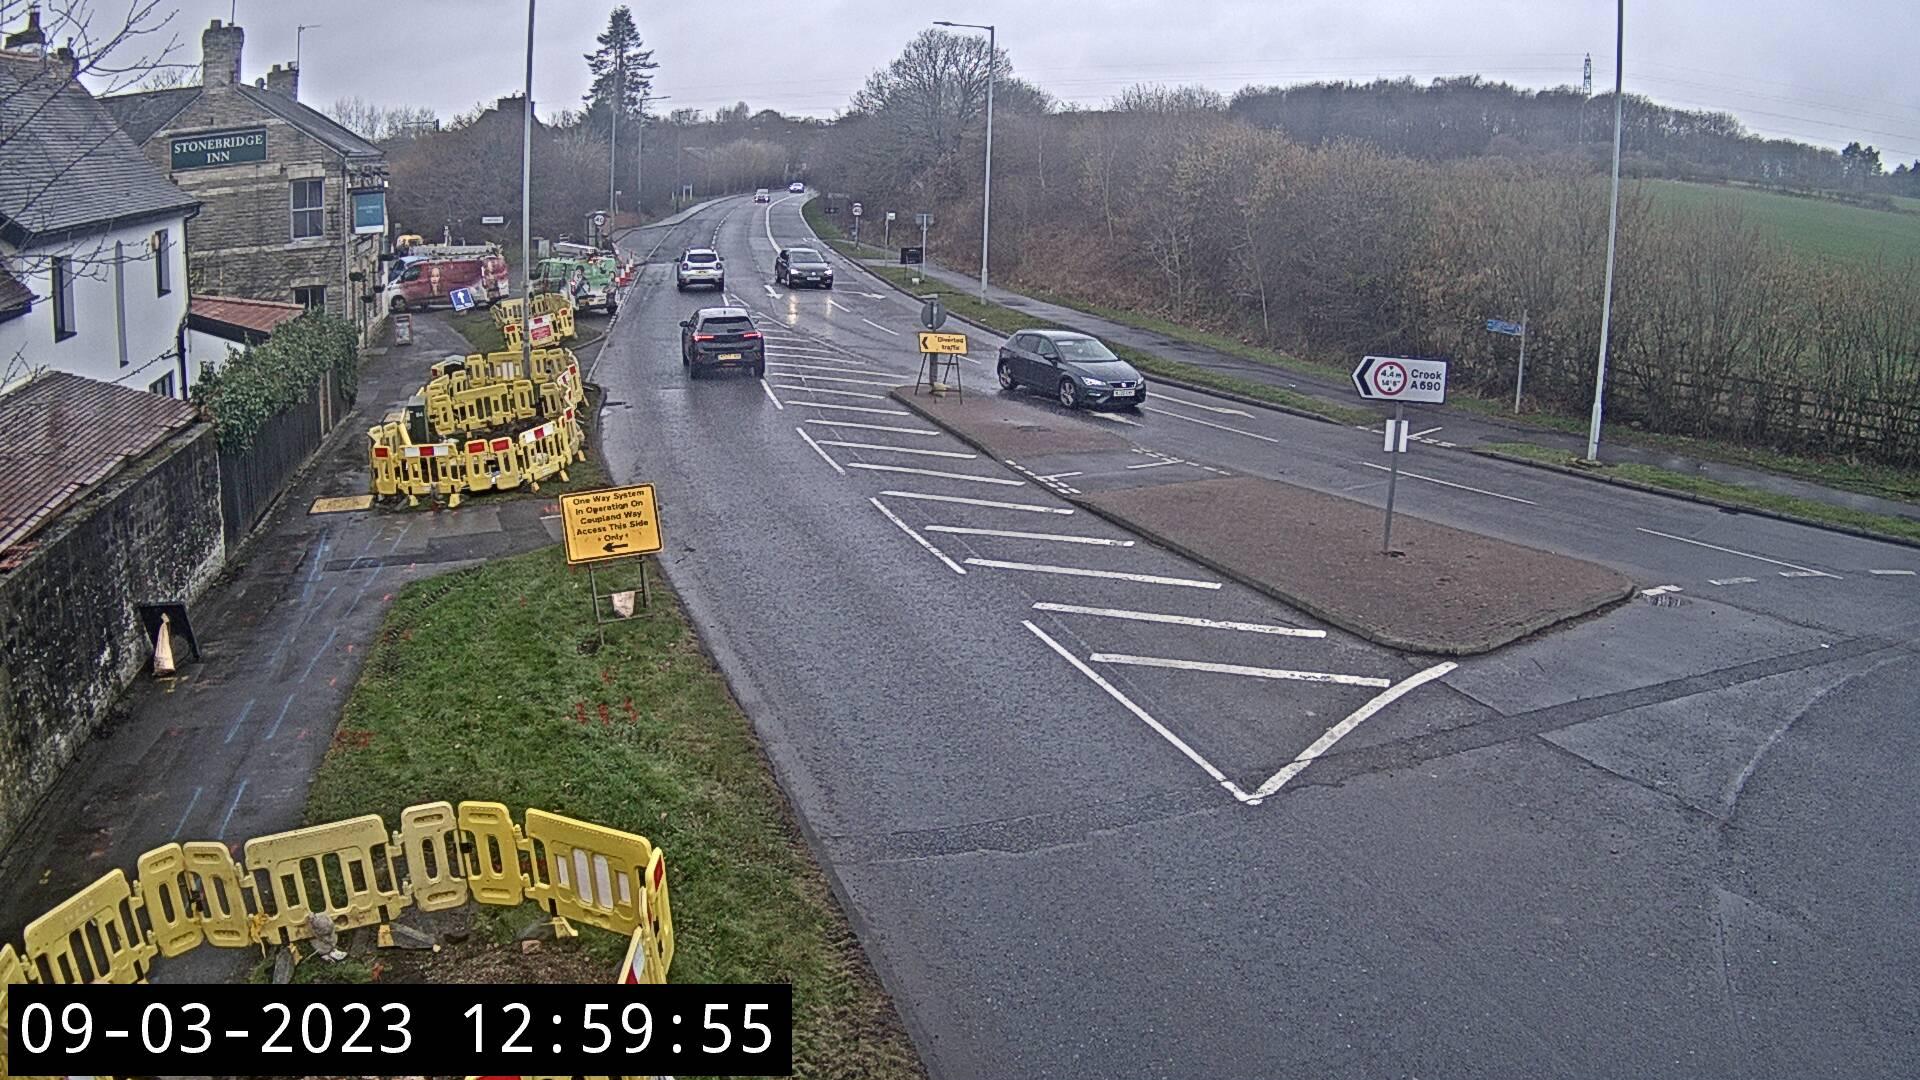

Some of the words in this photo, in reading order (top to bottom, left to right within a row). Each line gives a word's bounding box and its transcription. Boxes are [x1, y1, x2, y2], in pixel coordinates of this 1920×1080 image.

[174, 134, 263, 153] STONEBRIDGE
[206, 151, 230, 163] INN
[1411, 369, 1442, 380] Crook
[573, 498, 591, 506] One
[593, 494, 611, 503] Way
[613, 490, 645, 500] System
[586, 502, 629, 514] Operation
[580, 513, 621, 525] Coupland
[624, 510, 642, 518] Way
[576, 526, 607, 535] Access
[609, 521, 627, 530] This
[630, 519, 649, 528] Side
[604, 533, 624, 542] Only
